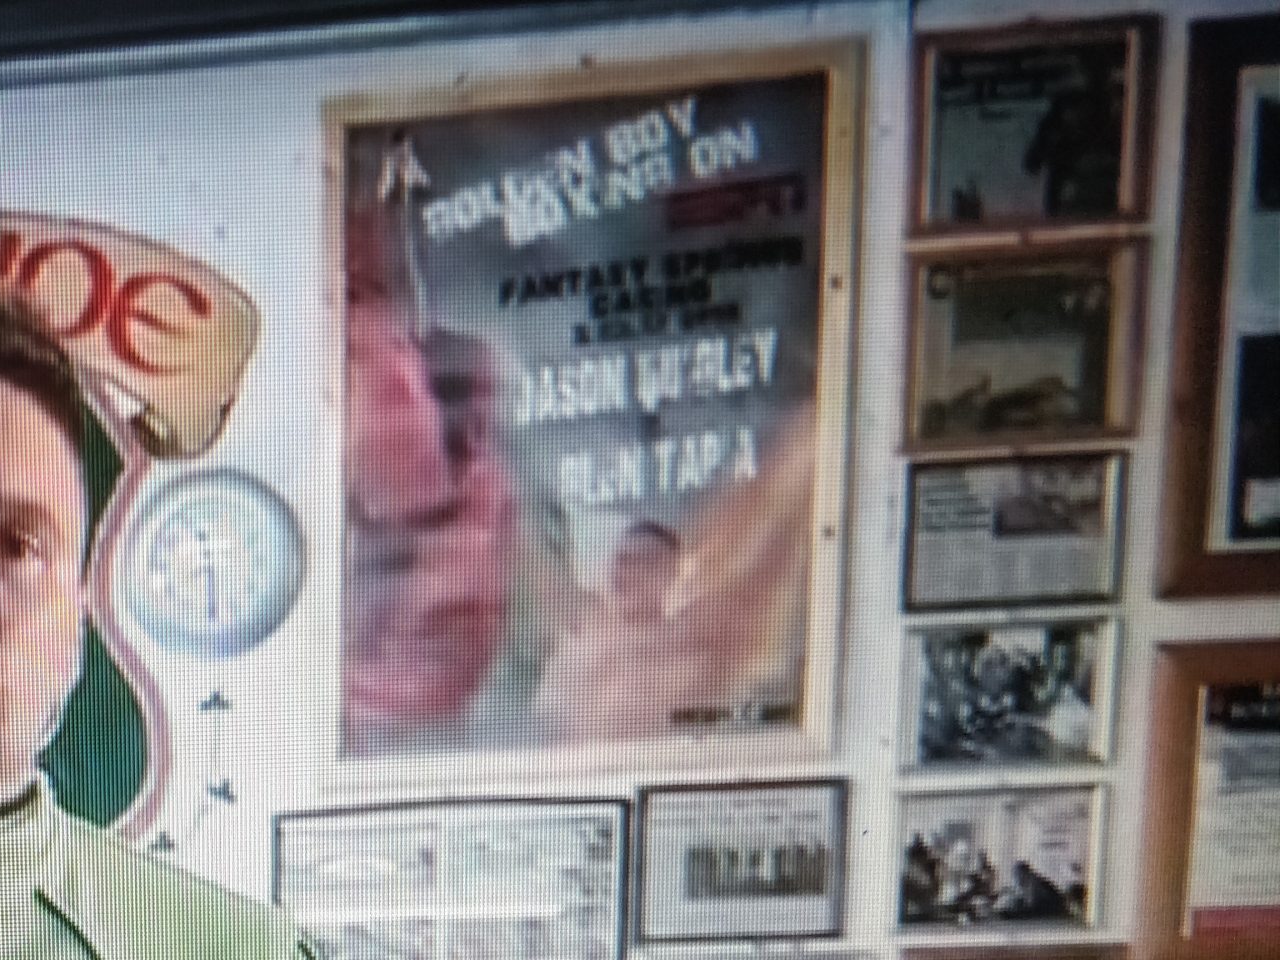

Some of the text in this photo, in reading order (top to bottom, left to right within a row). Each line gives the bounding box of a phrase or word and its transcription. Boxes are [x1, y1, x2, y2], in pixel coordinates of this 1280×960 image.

[605, 98, 697, 164] BOY
[689, 122, 758, 177] ON
[498, 255, 649, 308] FANTASY
[515, 352, 629, 425] JASON
